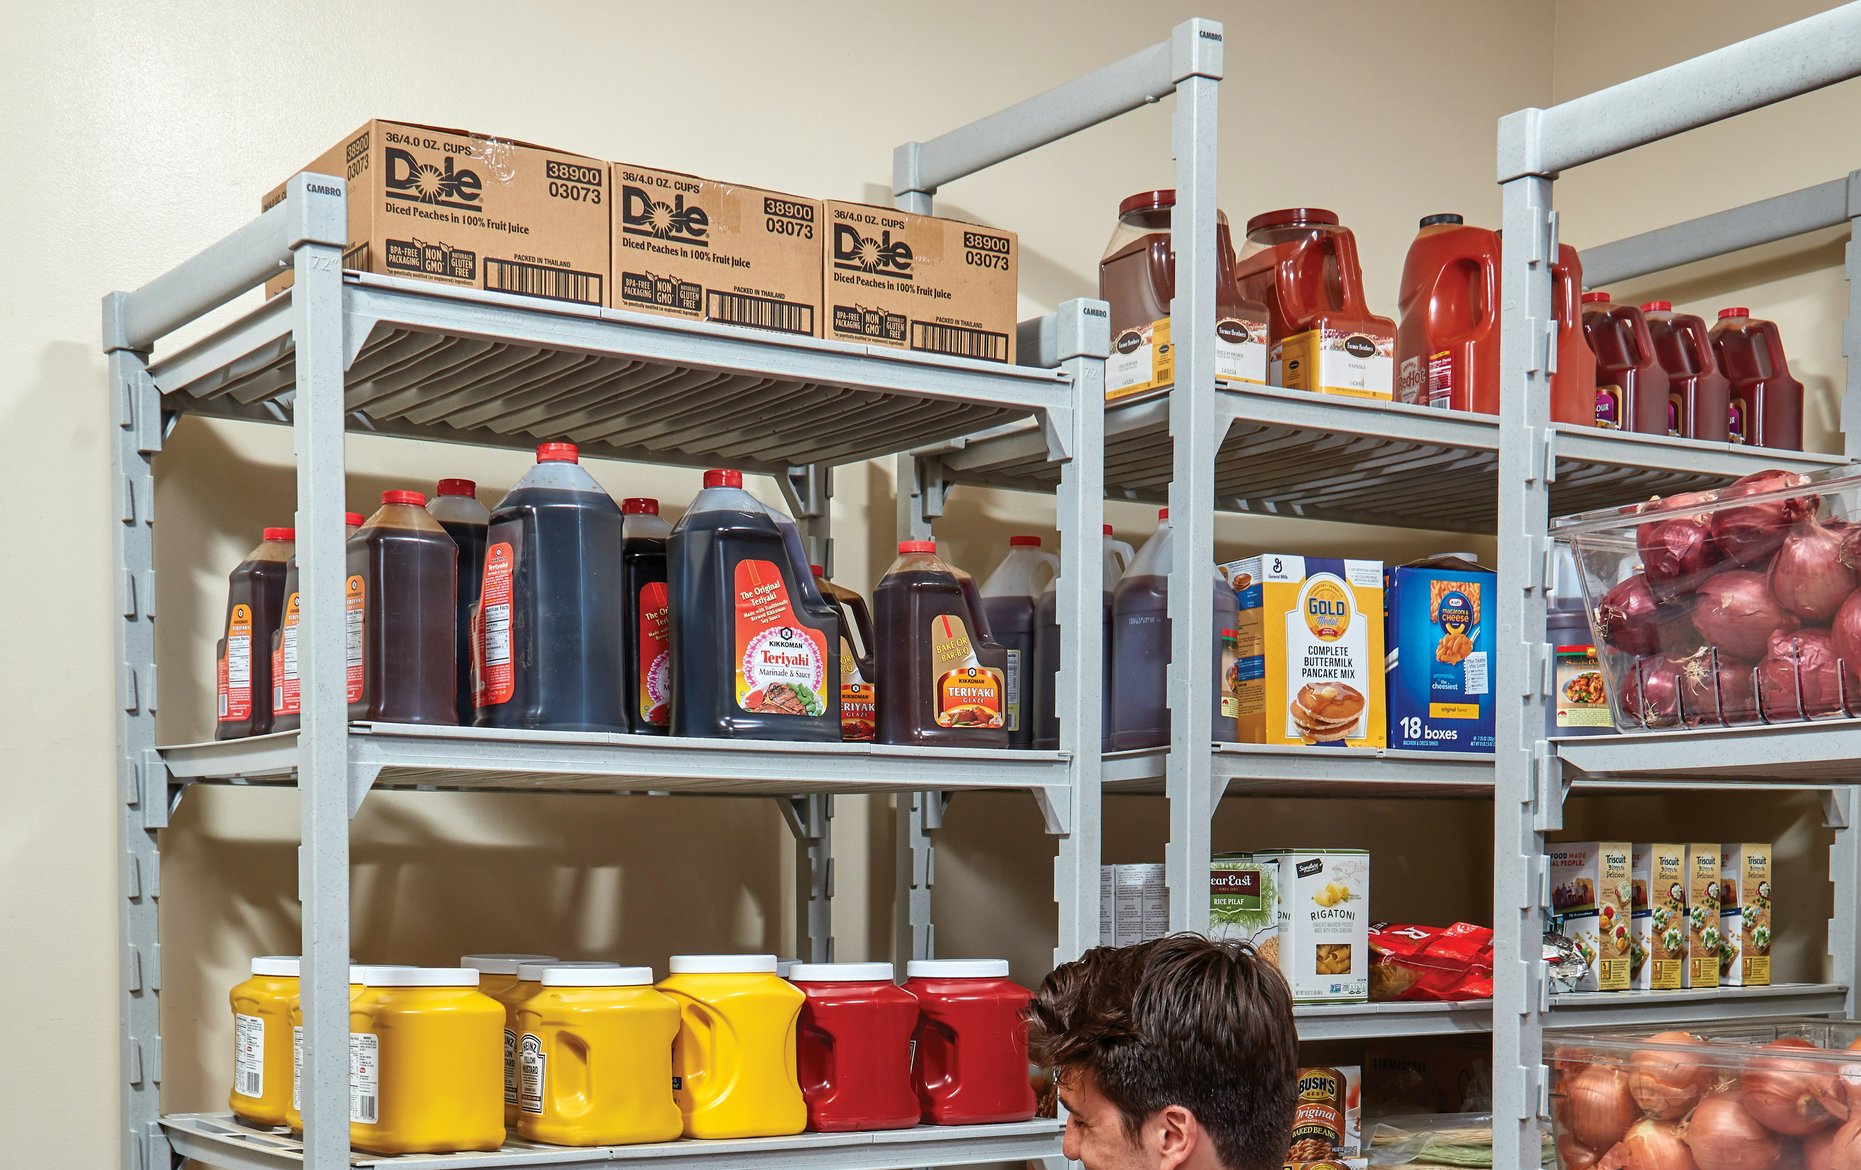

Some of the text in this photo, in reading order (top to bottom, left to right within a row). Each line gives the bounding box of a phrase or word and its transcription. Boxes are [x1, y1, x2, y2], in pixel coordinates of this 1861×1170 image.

[1199, 30, 1222, 42] CAMBRO
[347, 134, 369, 161] 38900
[386, 132, 472, 156] 36/4.0 OZ. CUPS
[347, 153, 369, 181] 03073
[385, 147, 482, 201] Dole
[548, 163, 599, 183] 38900
[623, 172, 700, 194] 36/4.0 OZ. CUPS
[306, 184, 341, 197] CAMBRO
[549, 182, 602, 204] 03073
[623, 185, 708, 237] Dole
[766, 200, 811, 220] 38900
[386, 202, 529, 234] Diced Peaches in 100% Fruit Juice
[834, 210, 905, 230] 36/4.0 OZ. CUPS
[766, 218, 813, 240] 03073
[834, 222, 913, 270] Dole
[966, 234, 1008, 251] 38900
[389, 245, 418, 258] BPA-FREE
[425, 248, 443, 261] NON
[623, 237, 751, 269] Diced Peaches in 100% Fruit Juice
[388, 253, 420, 266] PACKAGING
[451, 257, 473, 269] GLUTEN
[514, 254, 535, 262] PACKED
[544, 258, 571, 268] THAILAND
[966, 251, 1009, 271] 03073
[455, 268, 469, 278] FREE
[734, 286, 753, 295] PACKED
[761, 290, 785, 300] THAILAND
[834, 272, 952, 300] Diced Peaches in 100% Fruit Juice
[1083, 307, 1107, 318] CAMBRO
[936, 316, 954, 324] PACKED
[961, 320, 983, 329] THAILAND
[740, 580, 781, 600] The Original
[751, 591, 777, 607] Teriyaki
[765, 599, 788, 611] Traditionally
[1308, 597, 1345, 616] GOLD
[751, 606, 786, 622] Brewed Kikkoman
[769, 614, 780, 622] Sauce
[1316, 616, 1340, 626] Medal
[769, 641, 803, 649] KIKKOMAN
[936, 636, 968, 654] BAKE OR
[1308, 645, 1349, 657] COMPLETE
[761, 650, 809, 667] Teriyaki
[1304, 657, 1353, 668] BUTTERMILK
[759, 668, 788, 677] Marinade
[796, 670, 811, 678] Sauce
[1302, 668, 1355, 679] PANCAKE MIX
[948, 687, 994, 698] TERIYAKI
[1432, 683, 1458, 691] cheesiest
[841, 702, 875, 712] ERIYAK
[1400, 716, 1458, 740] 18 boxes
[1606, 854, 1626, 864] Triscuit
[1659, 856, 1679, 866] Triscuit
[1696, 856, 1716, 865] Triscuit
[1747, 856, 1766, 865] Triscuit
[1211, 875, 1251, 886] ear East
[1311, 909, 1356, 921] RIGATONI
[523, 1041, 537, 1053] HEINZ
[1299, 1077, 1335, 1095] BUSH'S
[1292, 1126, 1336, 1140] BAKED BEANS
